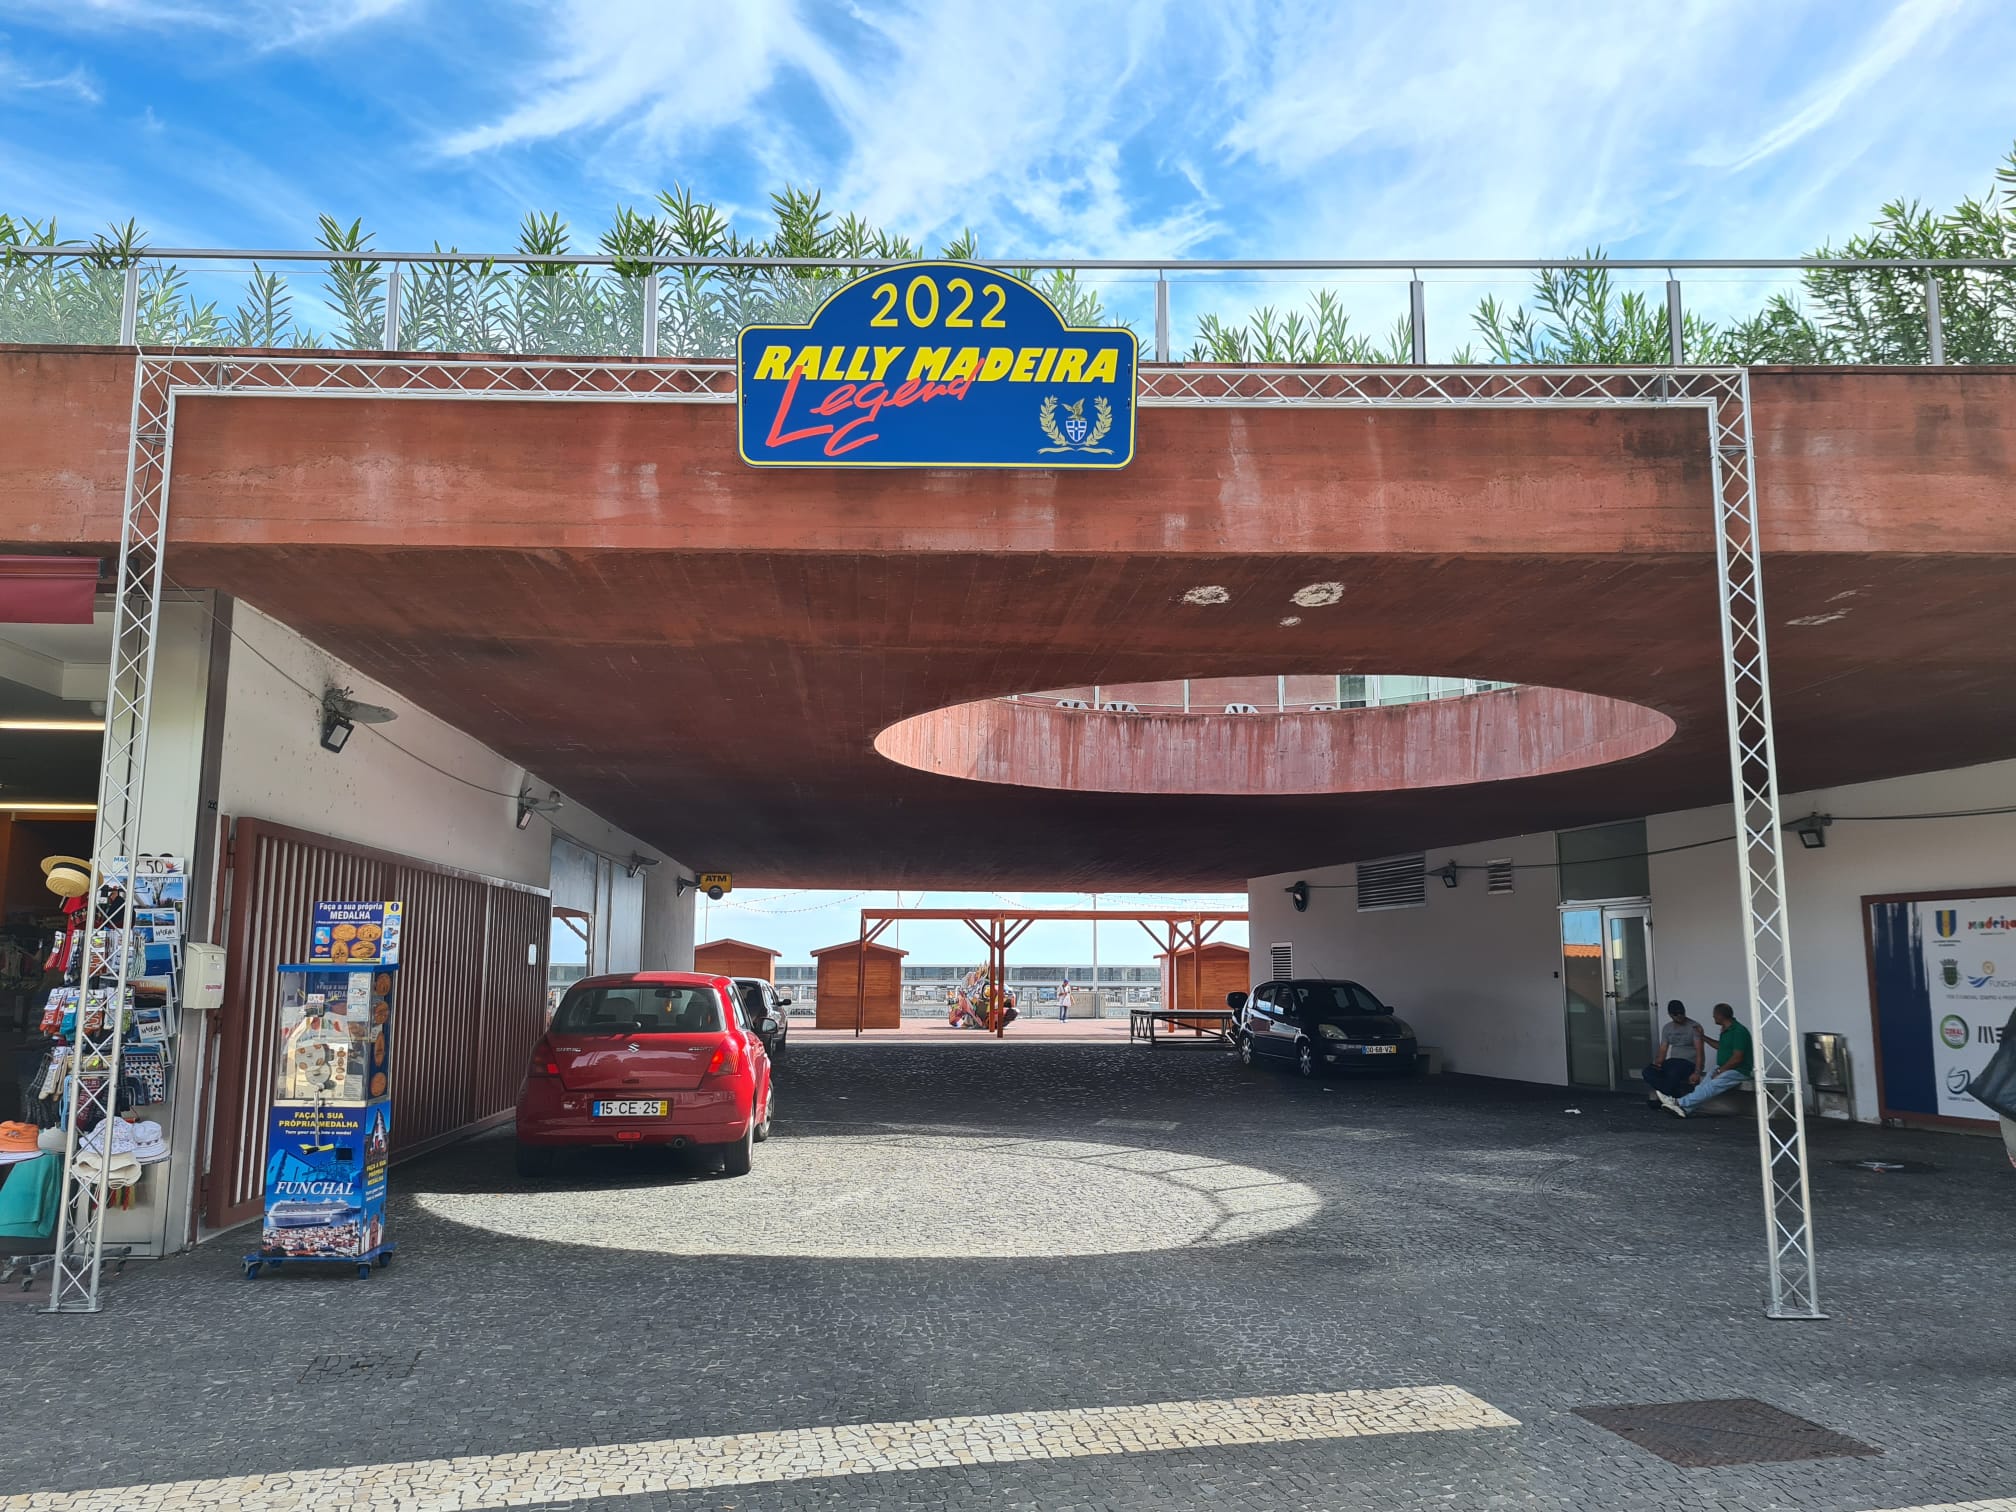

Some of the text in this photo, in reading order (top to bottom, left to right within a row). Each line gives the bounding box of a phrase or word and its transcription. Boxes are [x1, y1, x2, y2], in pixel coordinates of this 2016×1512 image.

[870, 275, 1006, 328] 2022
[753, 345, 1119, 383] RALLY MADEIRA
[765, 358, 985, 457] Legend
[319, 903, 336, 912] Faça
[357, 903, 383, 911] própria
[330, 911, 371, 920] MEDALHA
[294, 1111, 316, 1120] FAÇA
[279, 1119, 316, 1127] PRÓPRIA
[274, 1181, 354, 1195] FUNCHAL
